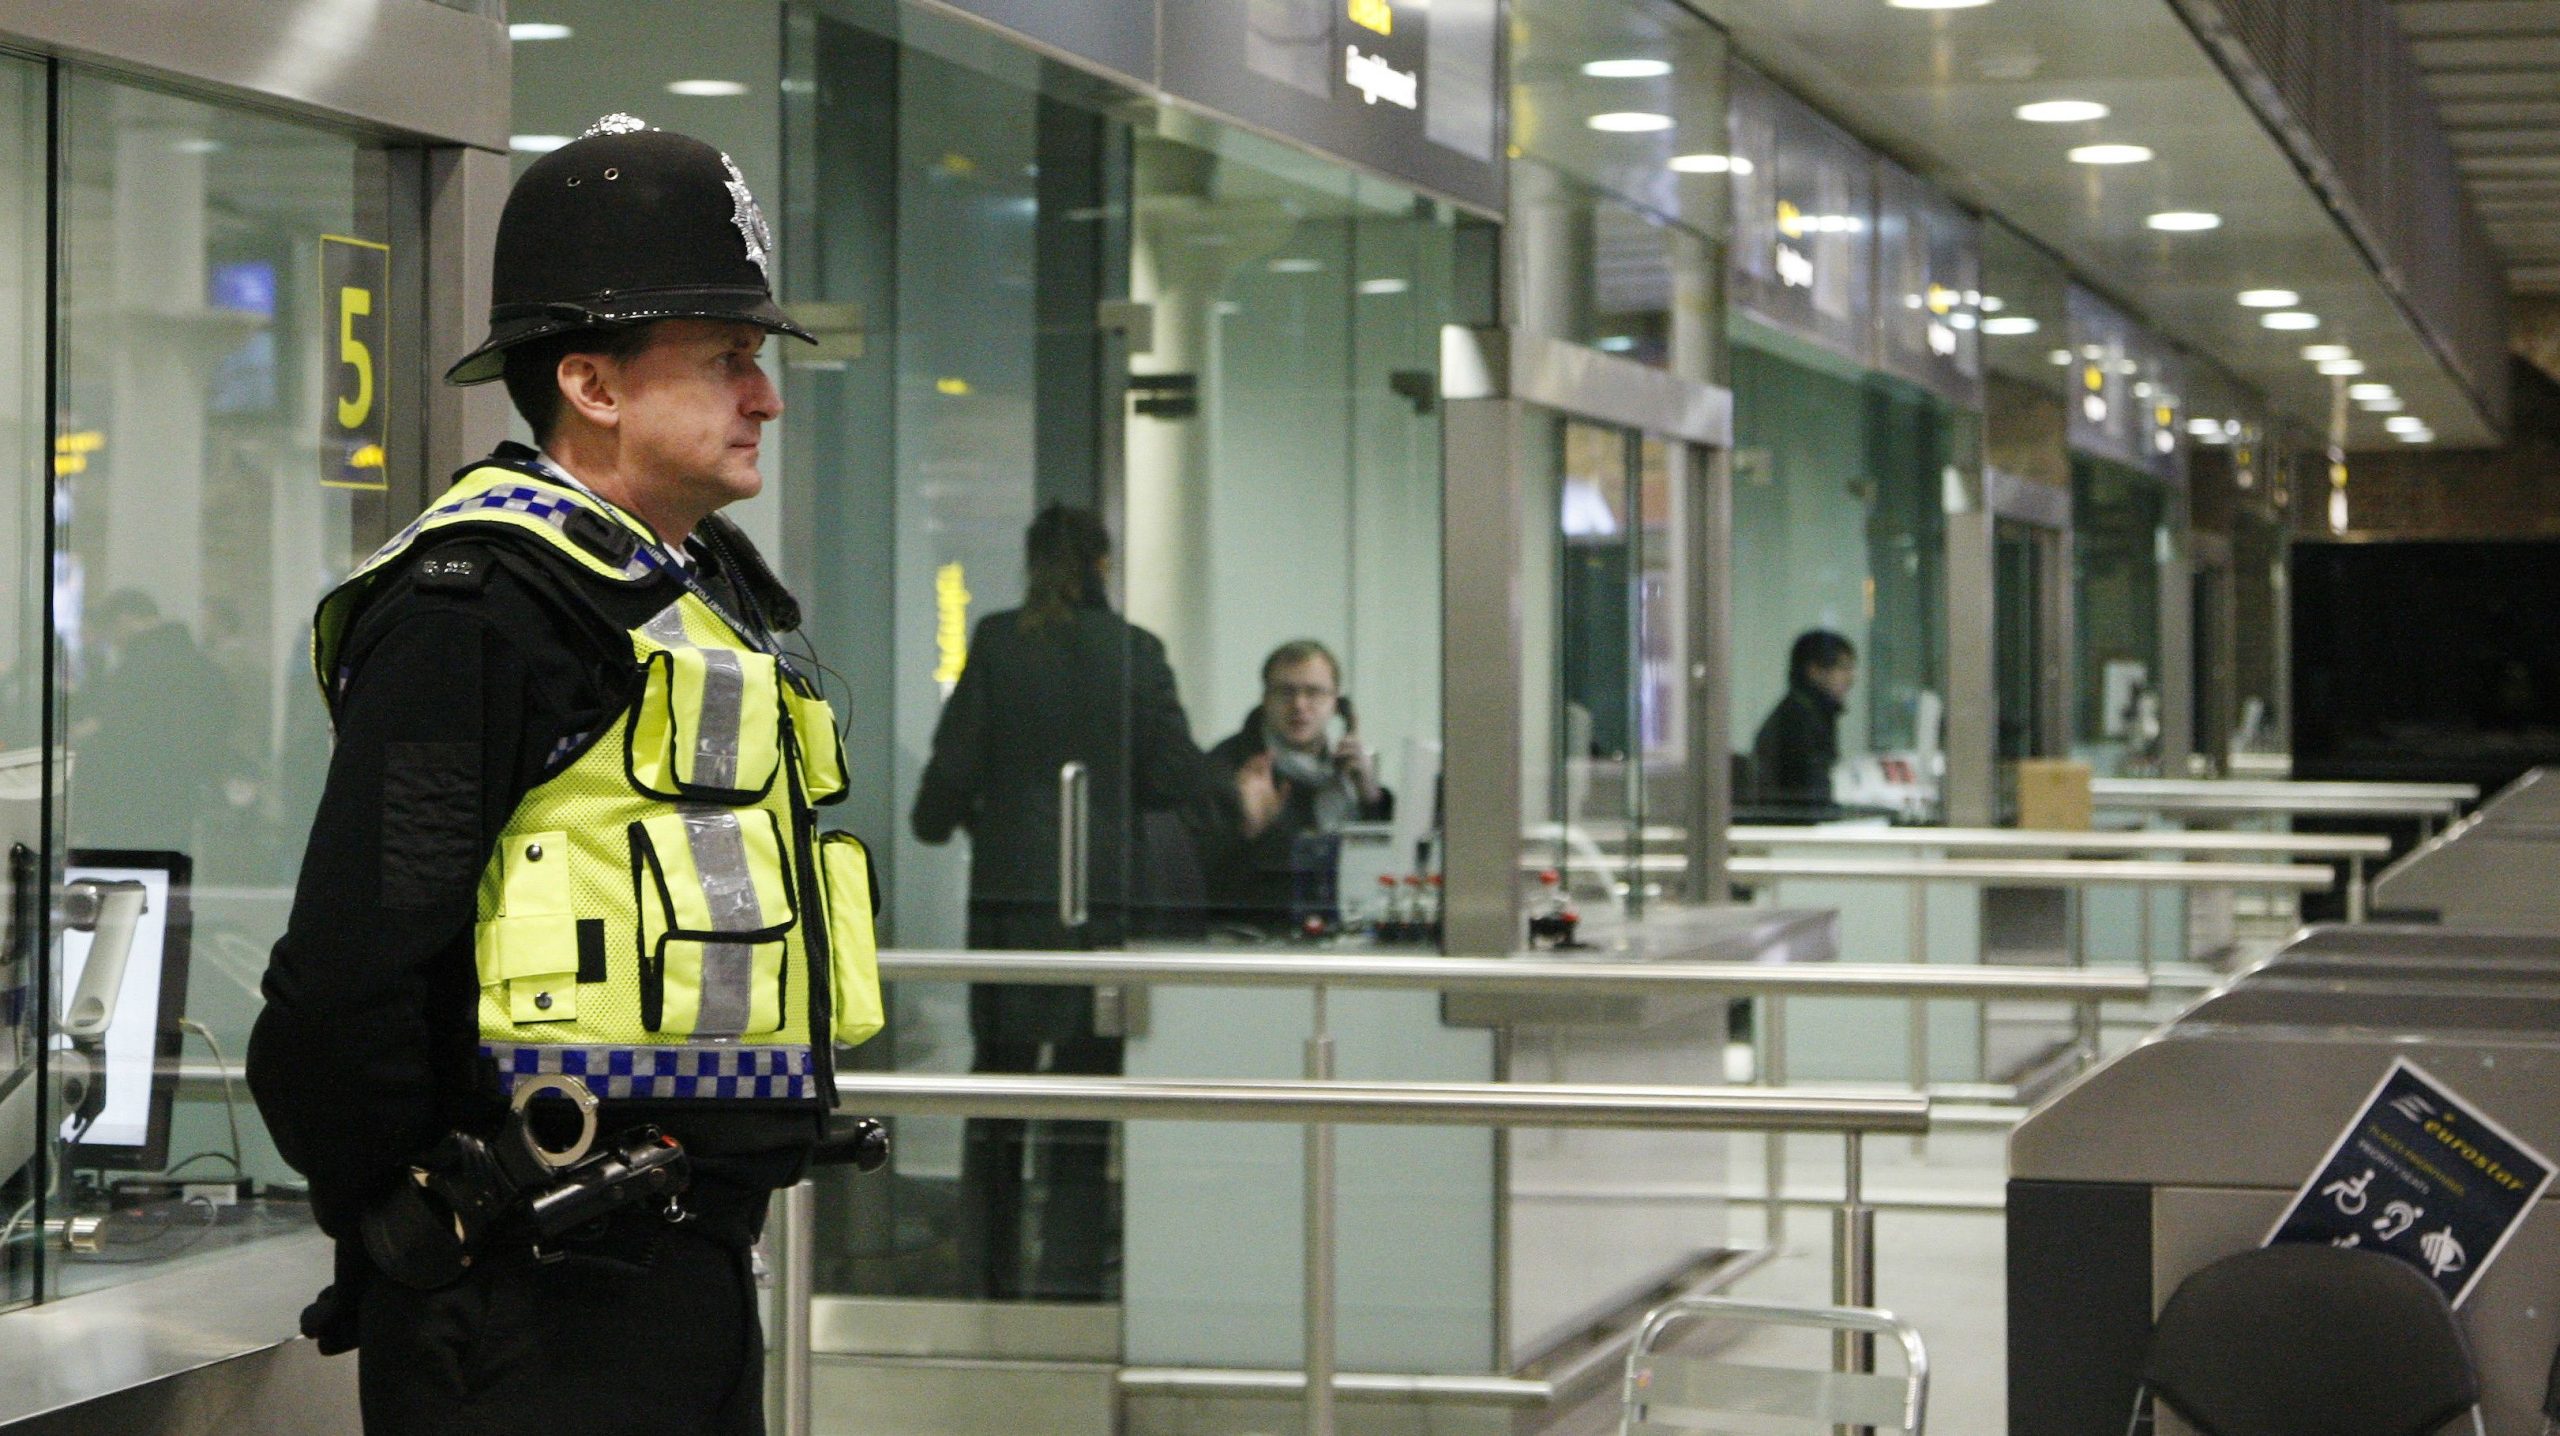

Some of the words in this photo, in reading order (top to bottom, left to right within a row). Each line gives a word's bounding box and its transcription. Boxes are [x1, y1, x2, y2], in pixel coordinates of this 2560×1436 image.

[339, 286, 372, 430] 5
[683, 576, 711, 602] POLICE
[2423, 1118, 2525, 1191] eurostar
